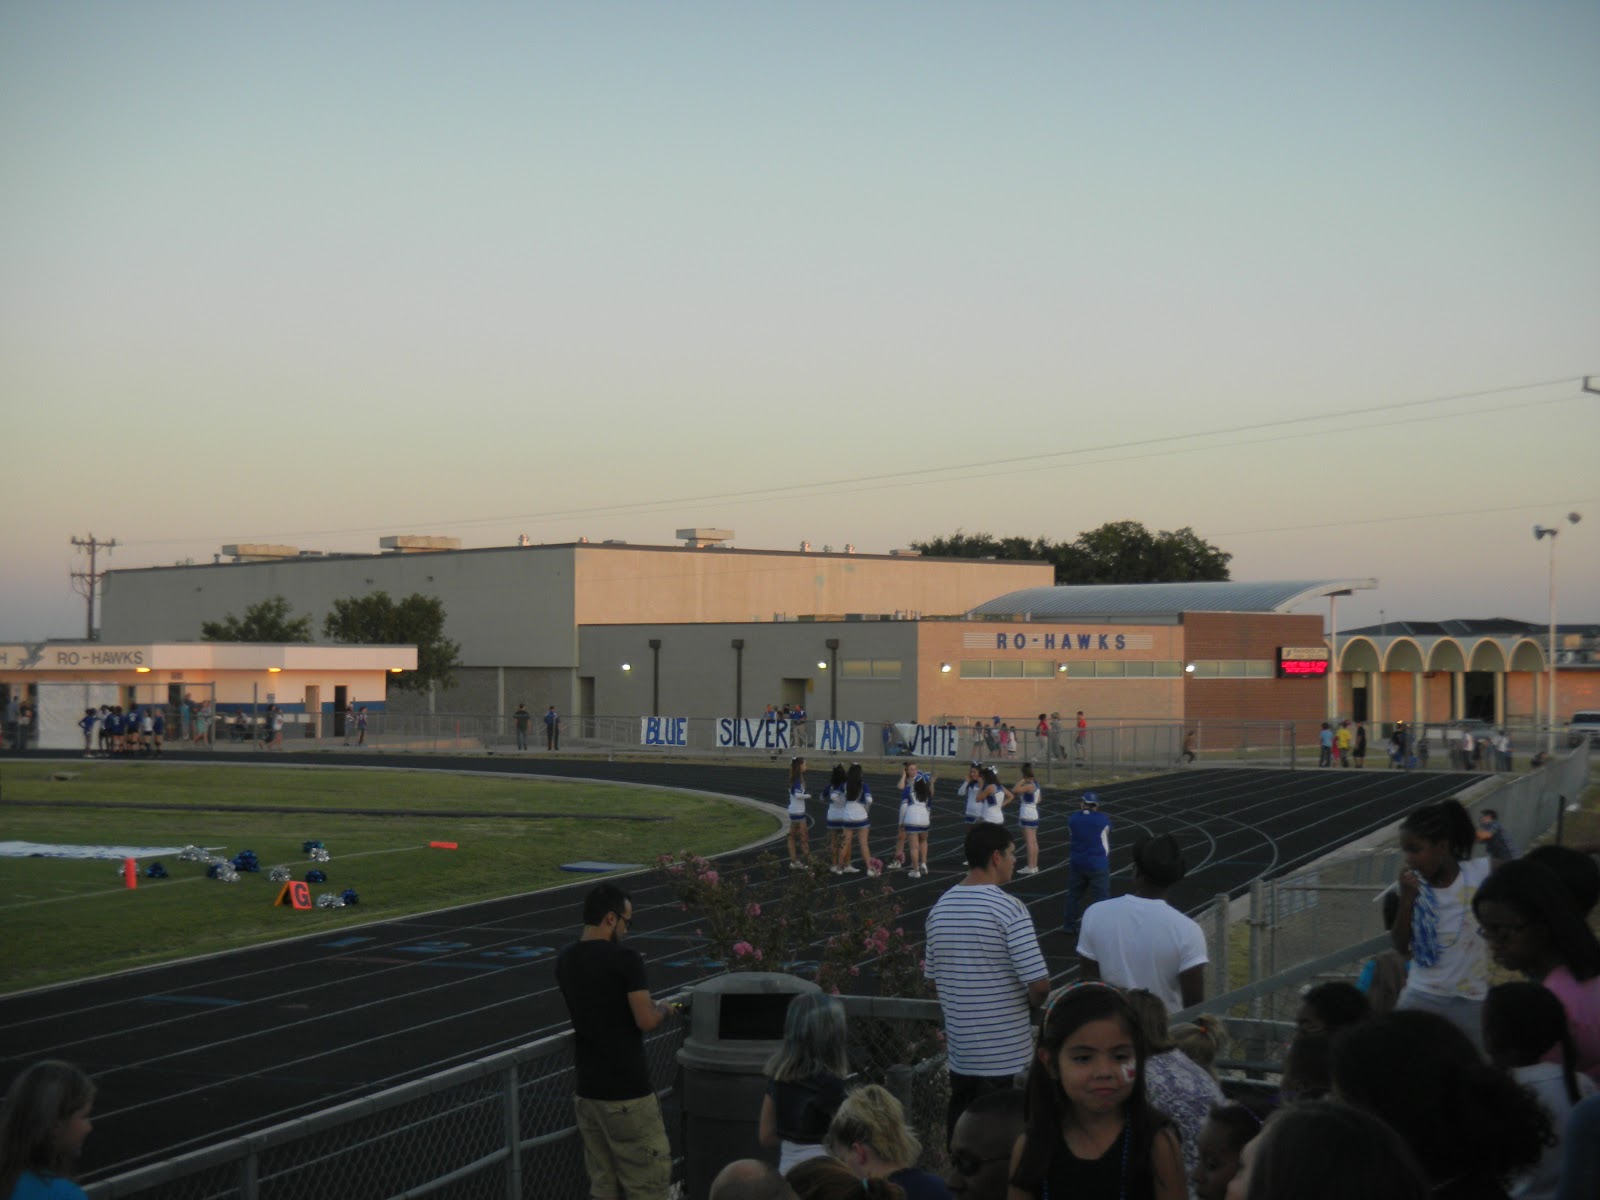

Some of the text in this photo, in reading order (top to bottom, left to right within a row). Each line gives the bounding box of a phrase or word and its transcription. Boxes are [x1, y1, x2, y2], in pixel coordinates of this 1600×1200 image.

[996, 632, 1126, 650] RO-HAWKS
[57, 651, 143, 665] RO-HAWKS
[645, 717, 687, 746] BLUE
[719, 718, 788, 748] SILVER
[820, 719, 861, 752] AND
[294, 883, 309, 907] G
